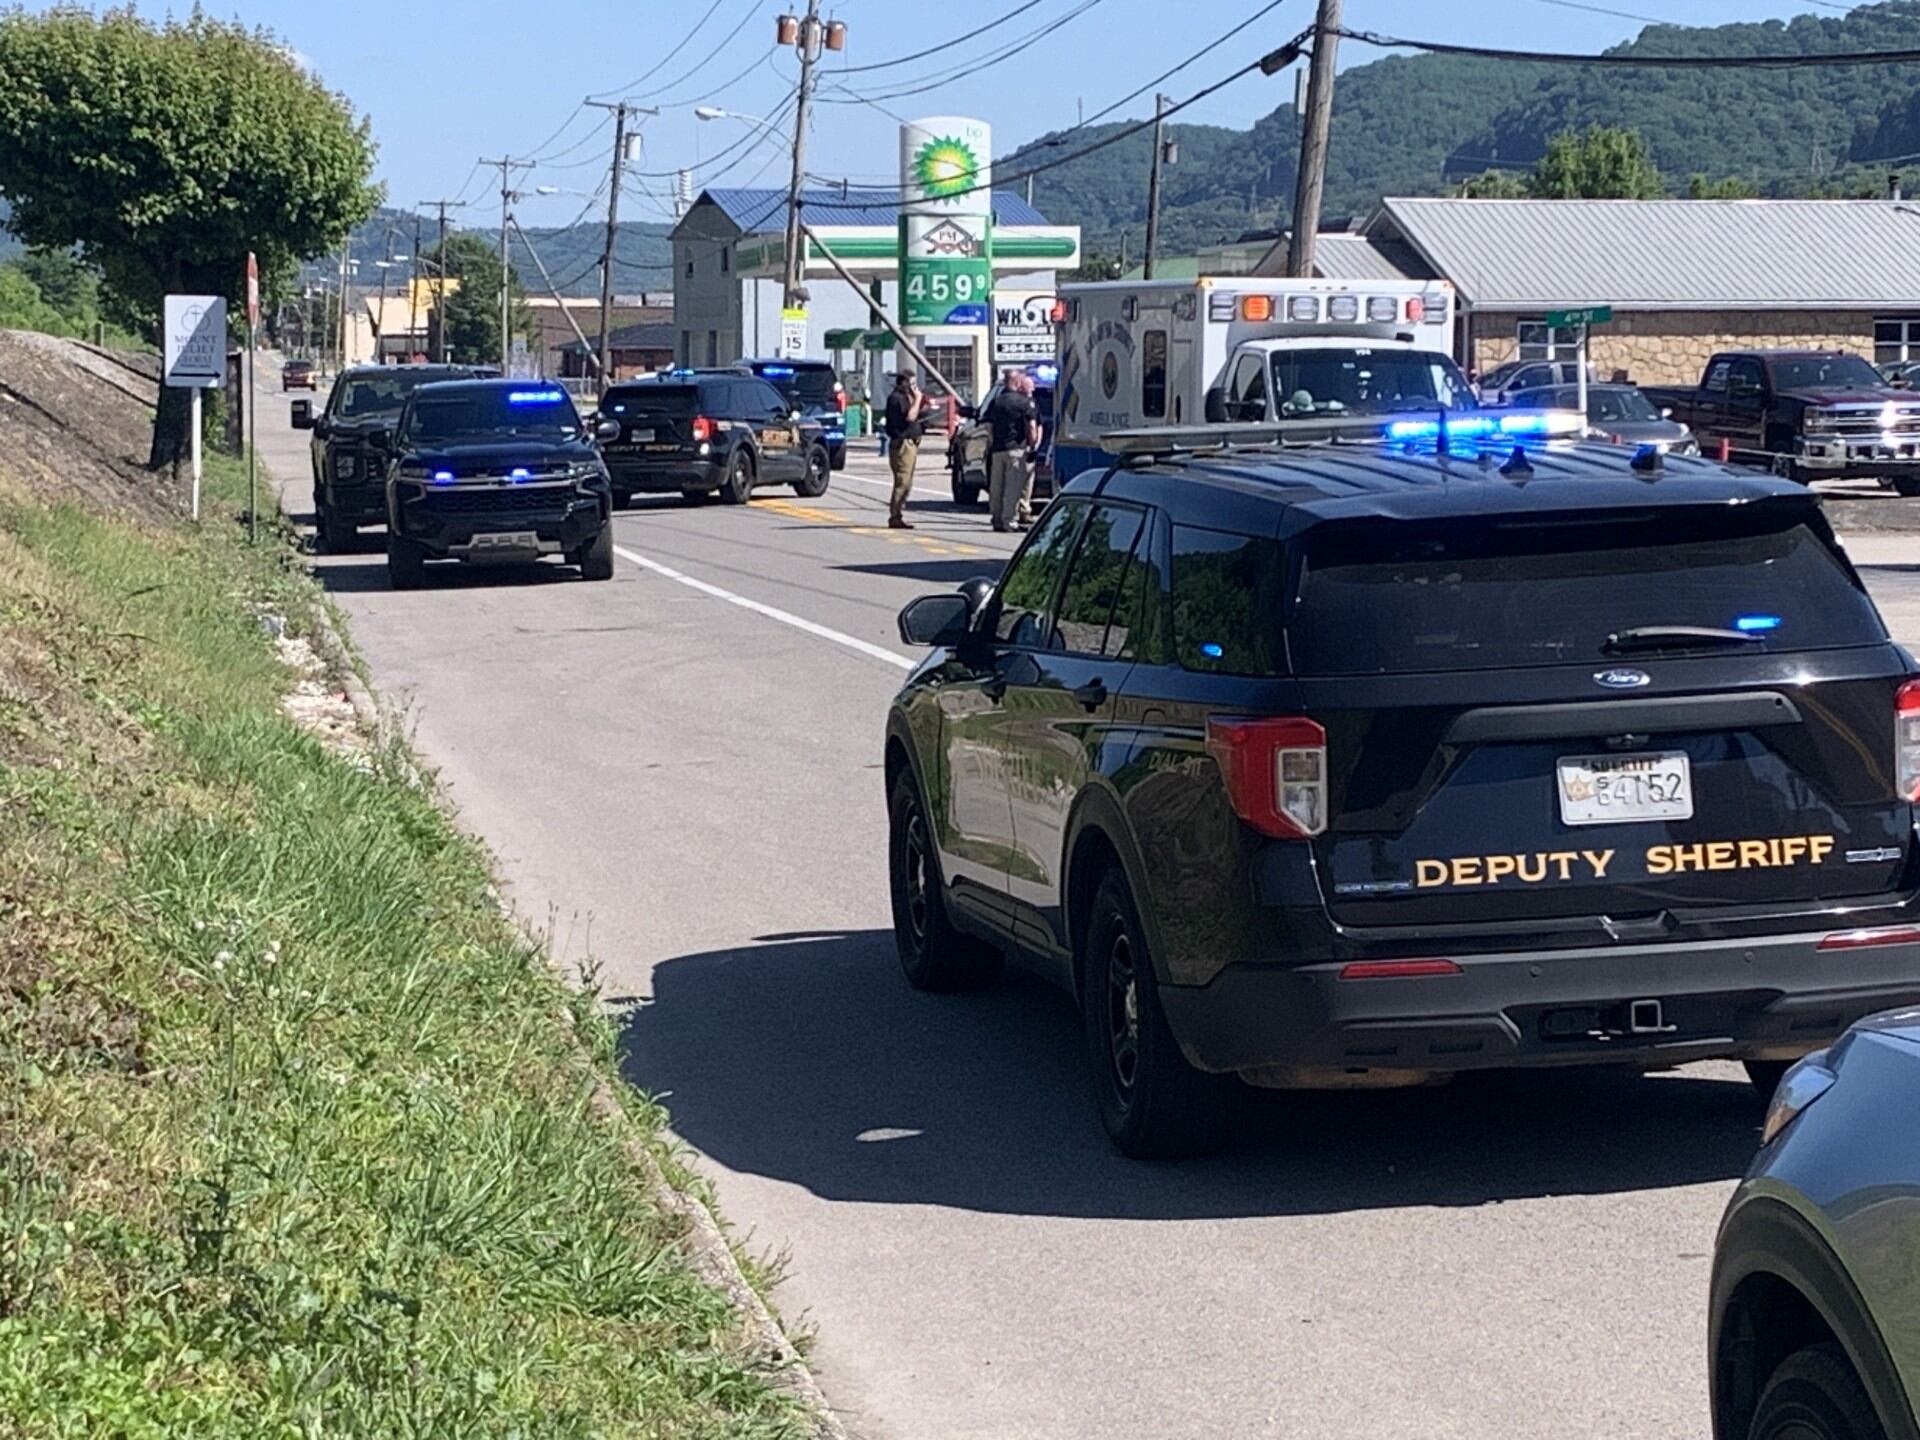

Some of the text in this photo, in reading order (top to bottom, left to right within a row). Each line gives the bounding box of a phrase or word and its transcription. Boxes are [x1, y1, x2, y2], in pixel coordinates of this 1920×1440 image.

[966, 125, 983, 141] bp
[174, 335, 217, 344] MOUNT
[785, 336, 802, 350] 15
[1414, 848, 1616, 889] DEPUTY
[1646, 834, 1835, 875] SHERIFF
